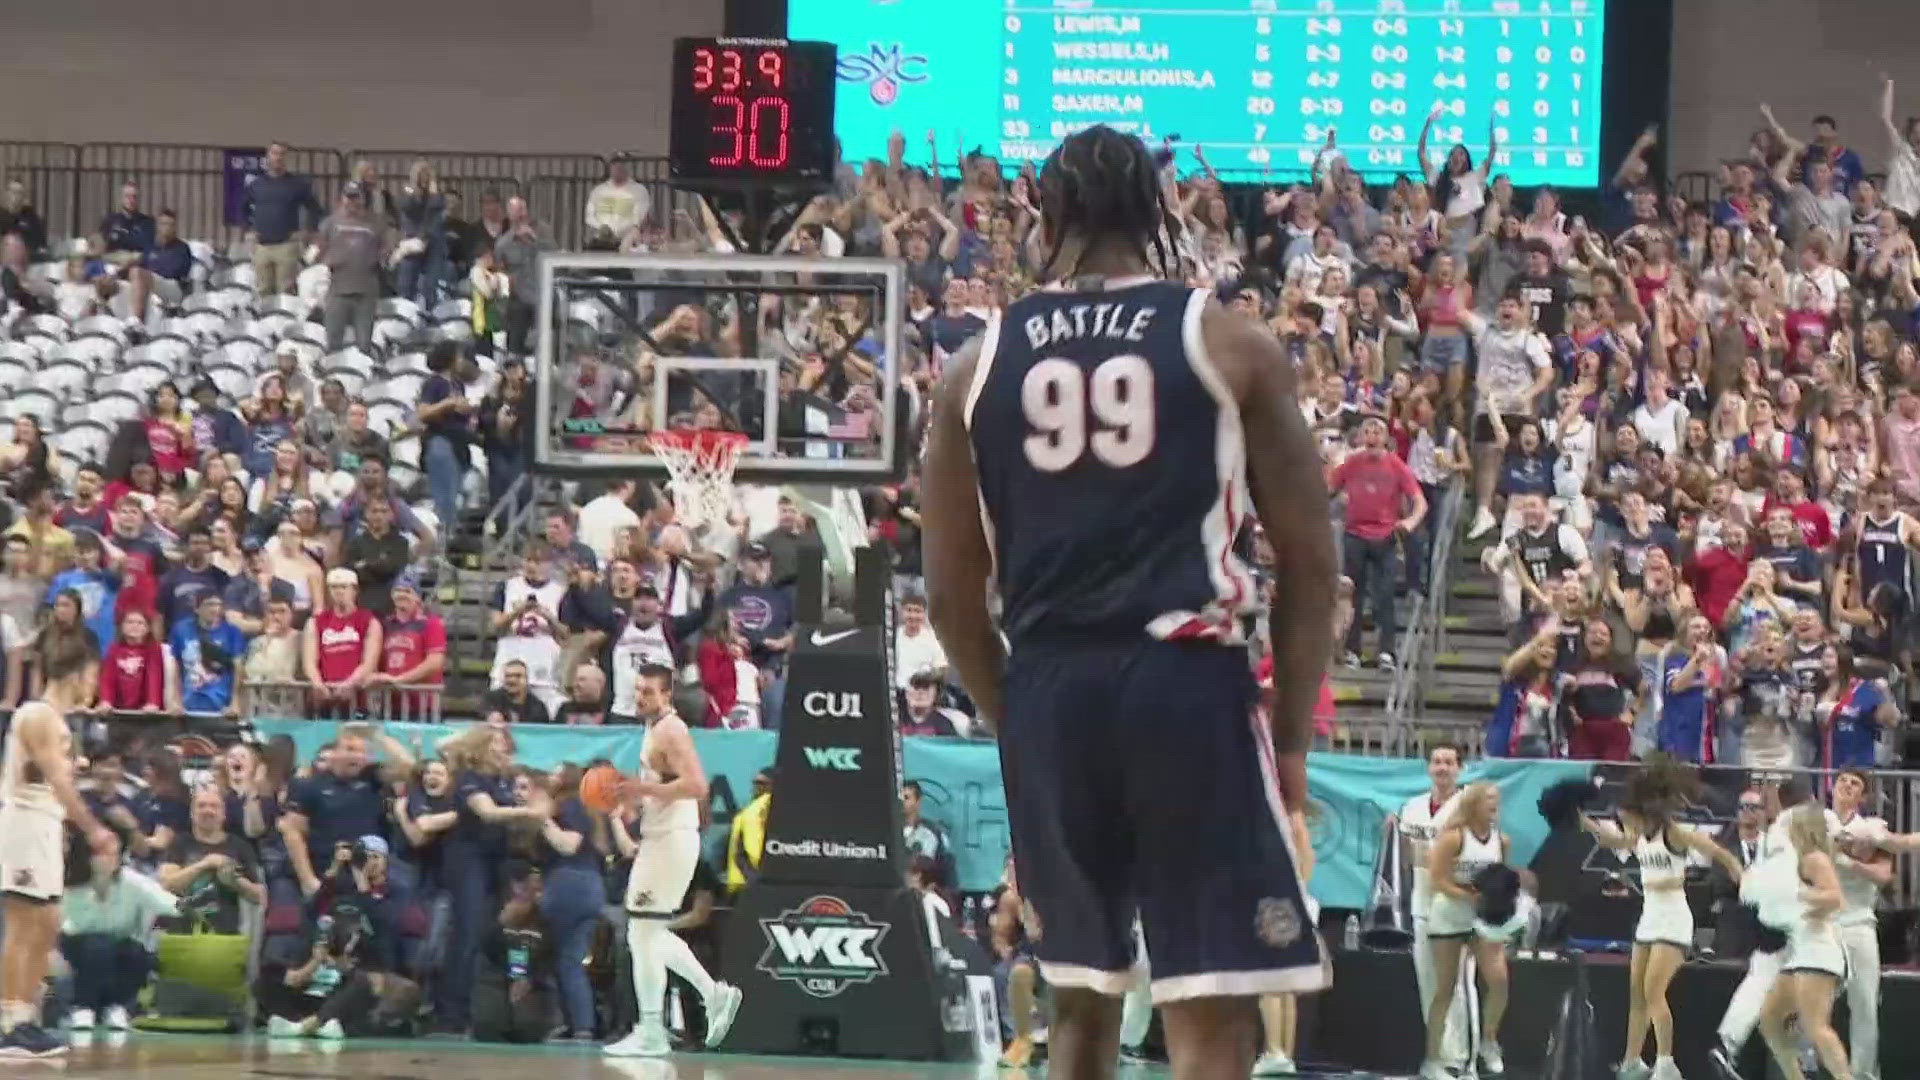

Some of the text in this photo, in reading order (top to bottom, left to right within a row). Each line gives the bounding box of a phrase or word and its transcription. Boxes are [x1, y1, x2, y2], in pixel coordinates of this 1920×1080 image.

[1054, 16, 1140, 34] LEWIS,M
[1053, 42, 1169, 61] WESSELS,H
[1535, 46, 1551, 63] 0
[1571, 46, 1586, 63] 0
[693, 49, 781, 89] 33.9
[1052, 69, 1215, 88] MARCIULIONIS,A
[1537, 72, 1549, 90] 7
[1052, 94, 1144, 114] SAXEN,M
[1534, 99, 1549, 117] 0
[709, 96, 789, 167] 30
[1025, 303, 1157, 350] BATTLE
[1021, 354, 1156, 472] 99
[803, 691, 863, 718] CU1
[803, 747, 861, 770] WCC
[766, 840, 821, 857] Credit
[822, 841, 876, 859] Union
[769, 925, 880, 968] WCC
